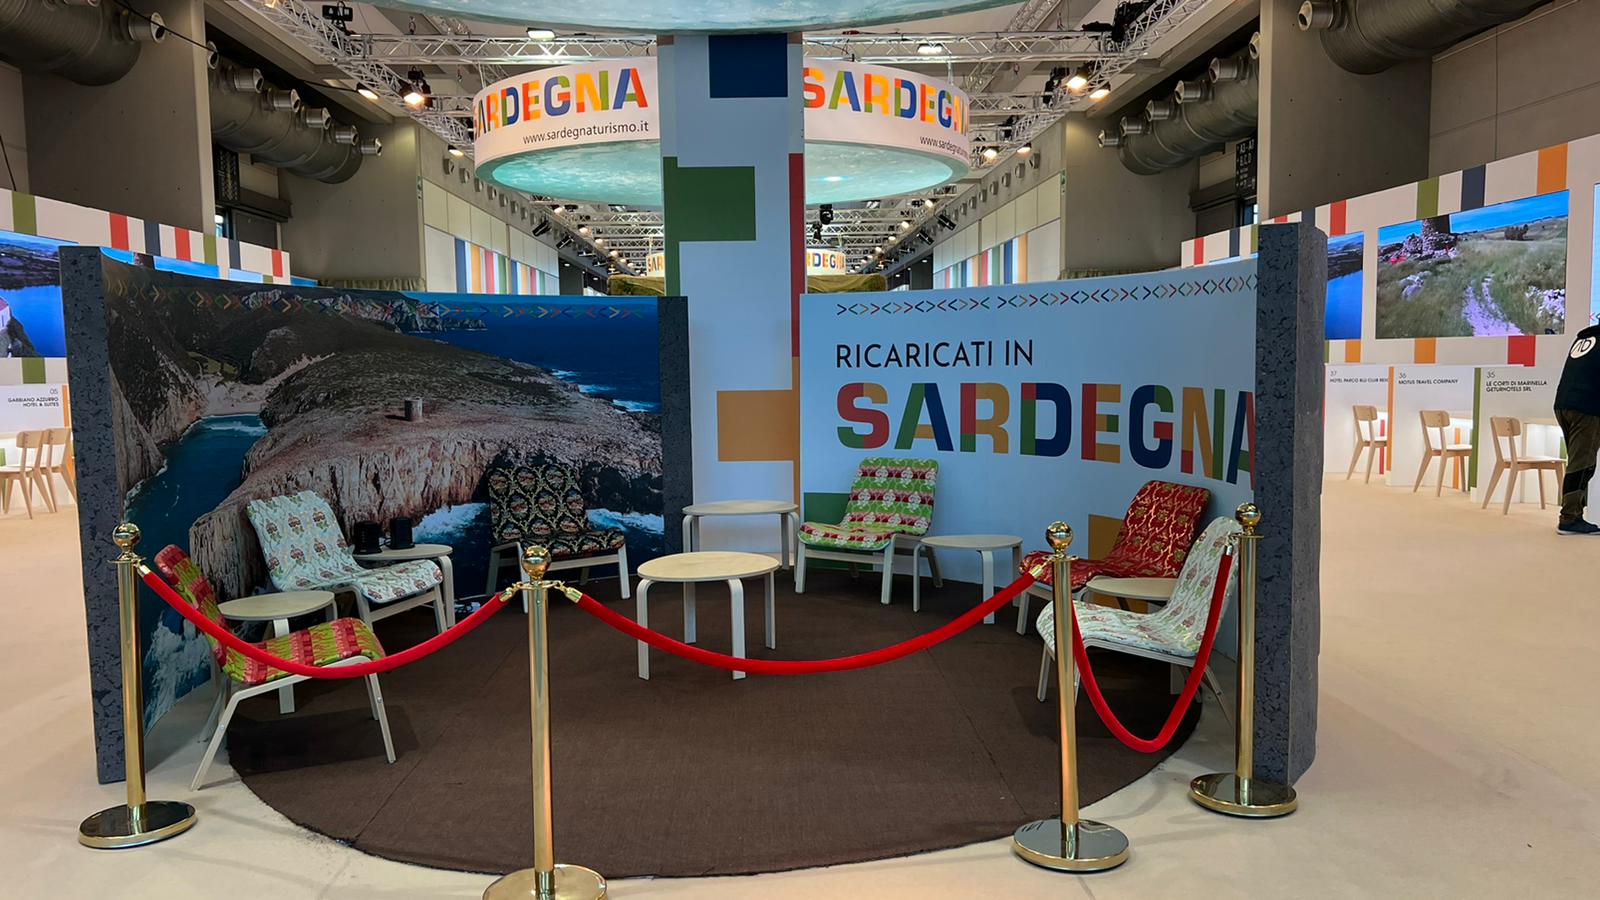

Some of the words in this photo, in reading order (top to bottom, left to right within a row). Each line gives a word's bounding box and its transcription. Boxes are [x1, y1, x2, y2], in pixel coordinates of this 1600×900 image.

[523, 120, 649, 144] www.sardegnaturismo.it
[836, 340, 993, 368] RICARICATI
[1005, 339, 1033, 367] IN
[836, 382, 1256, 491] SARDEGNA
